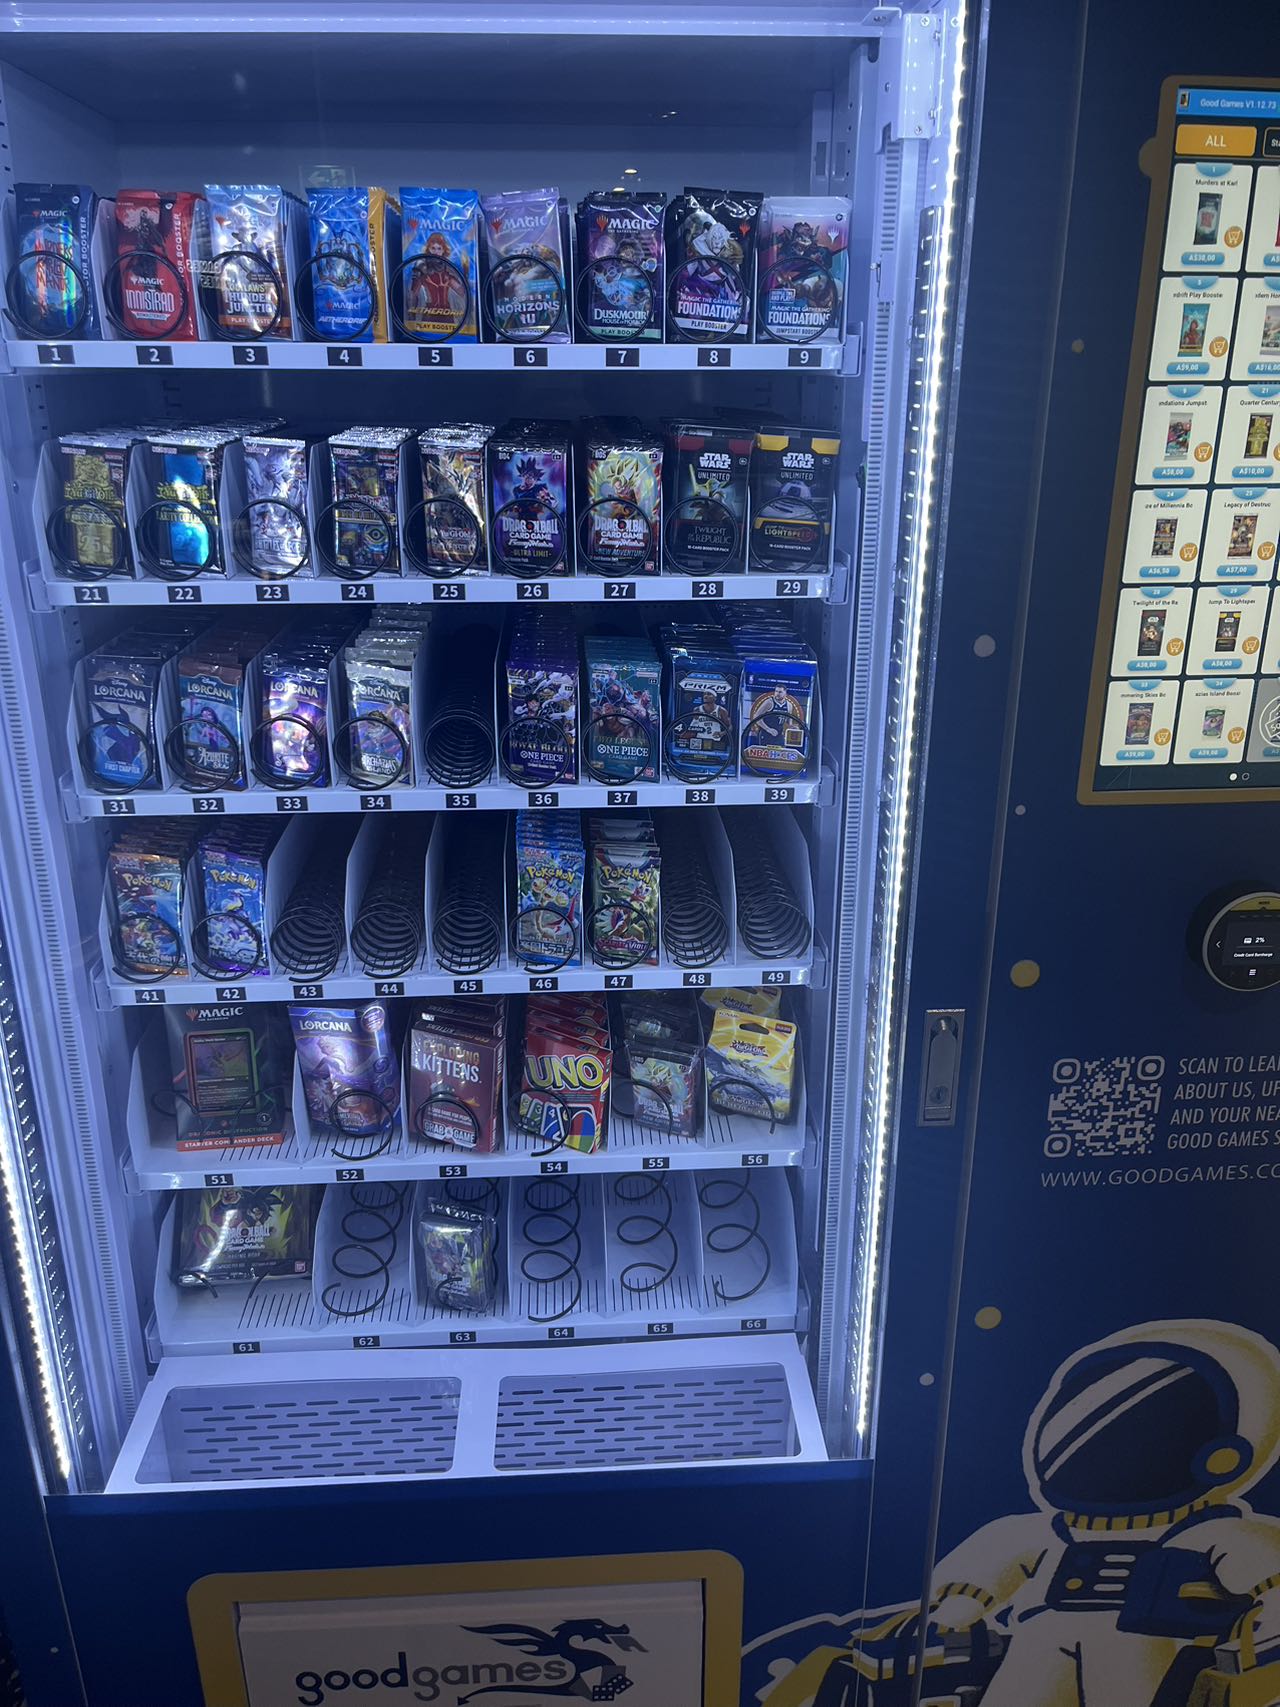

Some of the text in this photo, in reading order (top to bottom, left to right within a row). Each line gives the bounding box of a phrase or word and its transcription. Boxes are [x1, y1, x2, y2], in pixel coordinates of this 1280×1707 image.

[1200, 98, 1219, 107] Good
[1204, 135, 1227, 148] ALL
[420, 220, 465, 231] MAGIC
[503, 216, 547, 229] MAGIC
[608, 218, 655, 229] MAGIC
[80, 216, 88, 259] BOOSTER
[138, 277, 165, 285] MAGIC
[126, 289, 175, 312] INNISTRAD
[1189, 292, 1201, 300] Play
[333, 302, 360, 310] MAGIC
[497, 301, 560, 314] HORIZONS
[691, 320, 727, 330] PLAY BOOSTER
[51, 348, 61, 362] 1
[149, 348, 160, 362] 2
[245, 348, 255, 361] 3
[339, 350, 349, 363] 4
[431, 350, 440, 363] 5
[526, 350, 535, 363] 6
[618, 351, 626, 363] 7
[709, 352, 718, 363] 8
[800, 352, 809, 363] 9
[703, 452, 729, 461] STAR
[787, 452, 812, 461] STAR
[700, 458, 731, 469] WARS
[782, 457, 814, 469] WARS
[698, 472, 731, 481] UNLIMITED
[781, 472, 813, 481] UNLIMITED
[622, 532, 644, 540] GAME
[263, 587, 281, 598] 23
[348, 586, 367, 597] 24
[440, 586, 458, 597] 25
[524, 586, 542, 597] 26
[611, 584, 629, 596] 27
[699, 584, 717, 595] 28
[783, 582, 800, 593] 29
[82, 588, 101, 600] 21
[175, 588, 194, 600] 22
[187, 683, 233, 700] LORCANA
[684, 682, 727, 691] PRIZM
[94, 685, 146, 701] LORCANA
[675, 724, 683, 732] 4
[597, 745, 649, 757] ONE PIECE
[749, 749, 769, 758] NBA
[540, 752, 564, 763] PIECE
[535, 794, 552, 805] 36
[614, 792, 631, 803] 37
[692, 791, 709, 801] 38
[771, 789, 788, 800] 39
[200, 800, 218, 810] 32
[283, 799, 301, 809] 33
[367, 797, 384, 808] 34
[453, 796, 469, 806] 35
[110, 802, 128, 812] 31
[610, 977, 626, 986] 47
[689, 974, 705, 984] 48
[768, 973, 784, 982] 49
[381, 984, 398, 994] 44
[460, 981, 476, 991] 45
[535, 979, 552, 989] 46
[142, 991, 159, 1001] 41
[223, 989, 240, 999] 42
[300, 987, 316, 997] 43
[199, 1006, 244, 1019] MAGIC
[299, 1020, 353, 1033] LORCANA
[1178, 1057, 1220, 1075] SCAN
[1224, 1056, 1244, 1073] TO
[524, 1053, 604, 1091] UNO
[1174, 1082, 1228, 1100] ABOUT
[1231, 1081, 1256, 1100] US,
[1169, 1108, 1205, 1125] AND
[1209, 1106, 1250, 1124] YOUR
[257, 1135, 275, 1143] DECK
[454, 1129, 476, 1143] GAME
[1167, 1130, 1269, 1150] GOOD GAMES
[649, 1158, 663, 1167] 55
[748, 1156, 762, 1164] 56
[445, 1167, 461, 1175] 53
[547, 1163, 562, 1171] 54
[212, 1175, 227, 1184] 51
[342, 1170, 358, 1180] 52
[653, 1324, 668, 1333] 65
[747, 1320, 761, 1329] 66
[455, 1332, 470, 1341] 63
[554, 1328, 568, 1337] 64
[359, 1337, 374, 1346] 62
[240, 1343, 254, 1352] 61
[295, 1651, 568, 1706] goodgames
